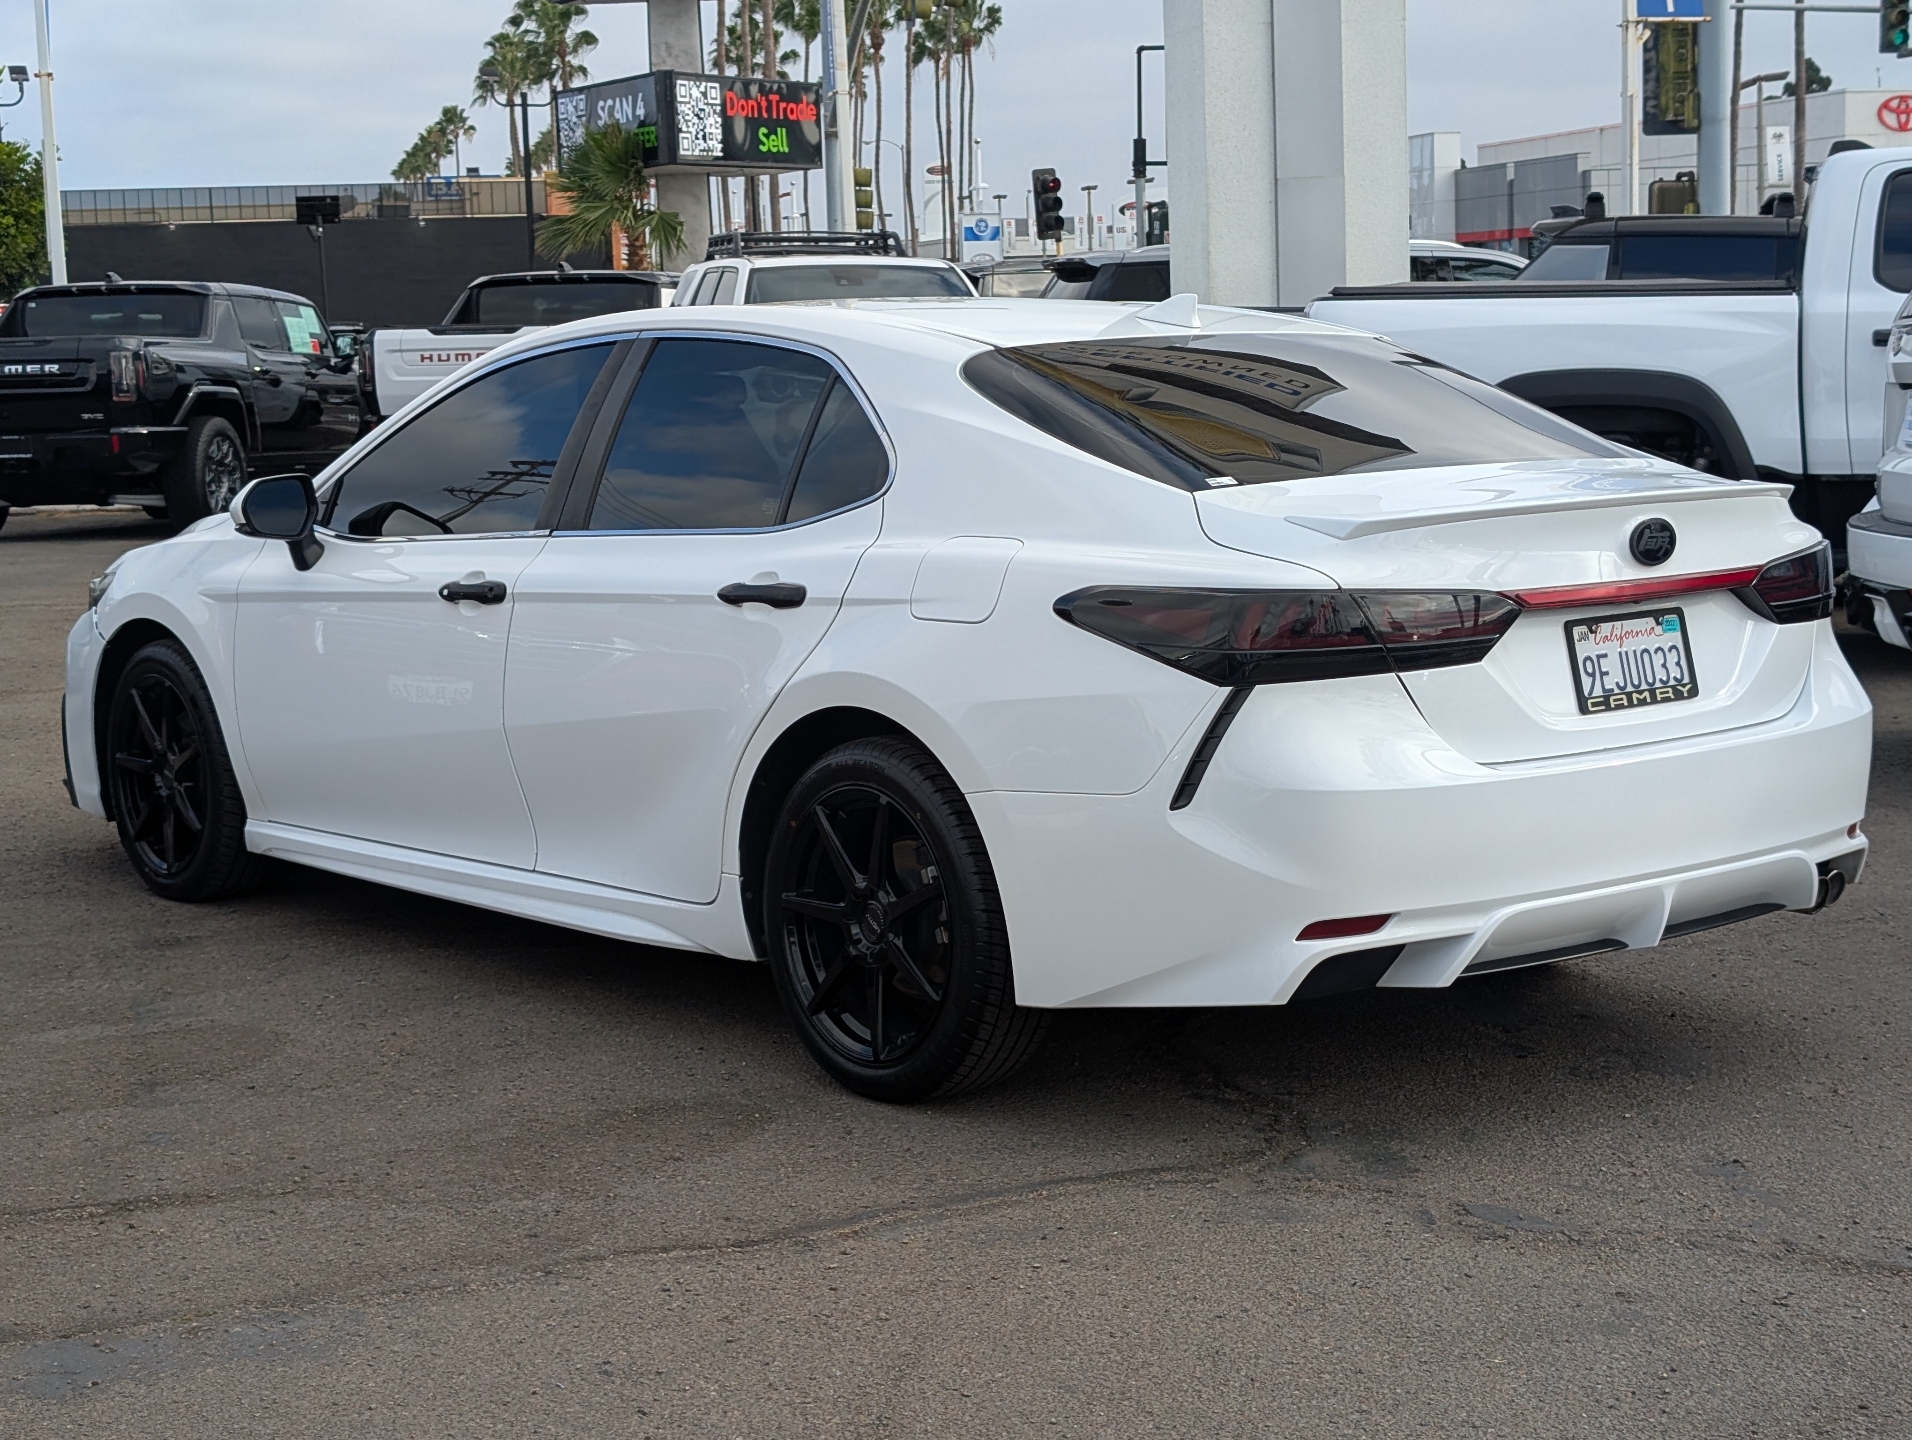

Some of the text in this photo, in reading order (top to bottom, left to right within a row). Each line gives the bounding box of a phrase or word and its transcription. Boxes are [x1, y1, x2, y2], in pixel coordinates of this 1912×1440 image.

[597, 92, 645, 127] SCAN 4
[725, 91, 817, 122] Don't Trade
[758, 127, 789, 154] Sell
[1, 364, 61, 375] MER
[1576, 630, 1590, 643] JAN
[1593, 622, 1665, 648] California
[1582, 641, 1686, 698] 9EJU033
[1587, 683, 1693, 712] CAMRY
[853, 758, 886, 773] SEASON
